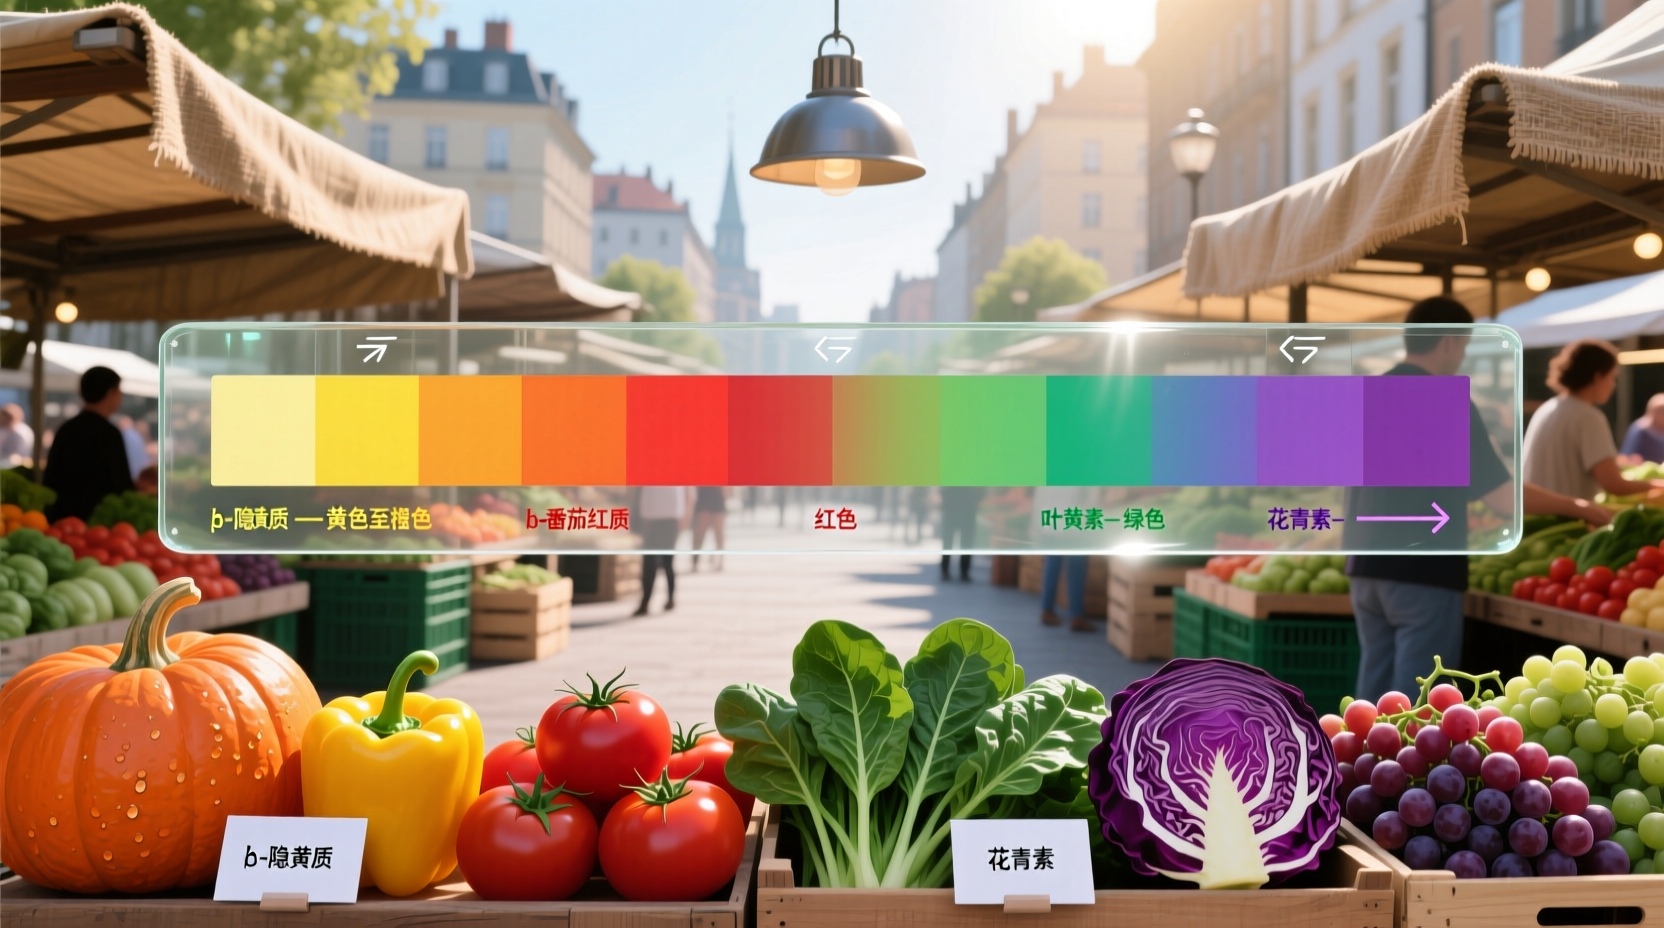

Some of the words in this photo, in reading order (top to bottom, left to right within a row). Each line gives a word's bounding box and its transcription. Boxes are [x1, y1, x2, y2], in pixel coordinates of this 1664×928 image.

[526, 506, 629, 531] b-番茄红质
[814, 507, 857, 530] 红色
[987, 846, 1054, 871] 花青素
